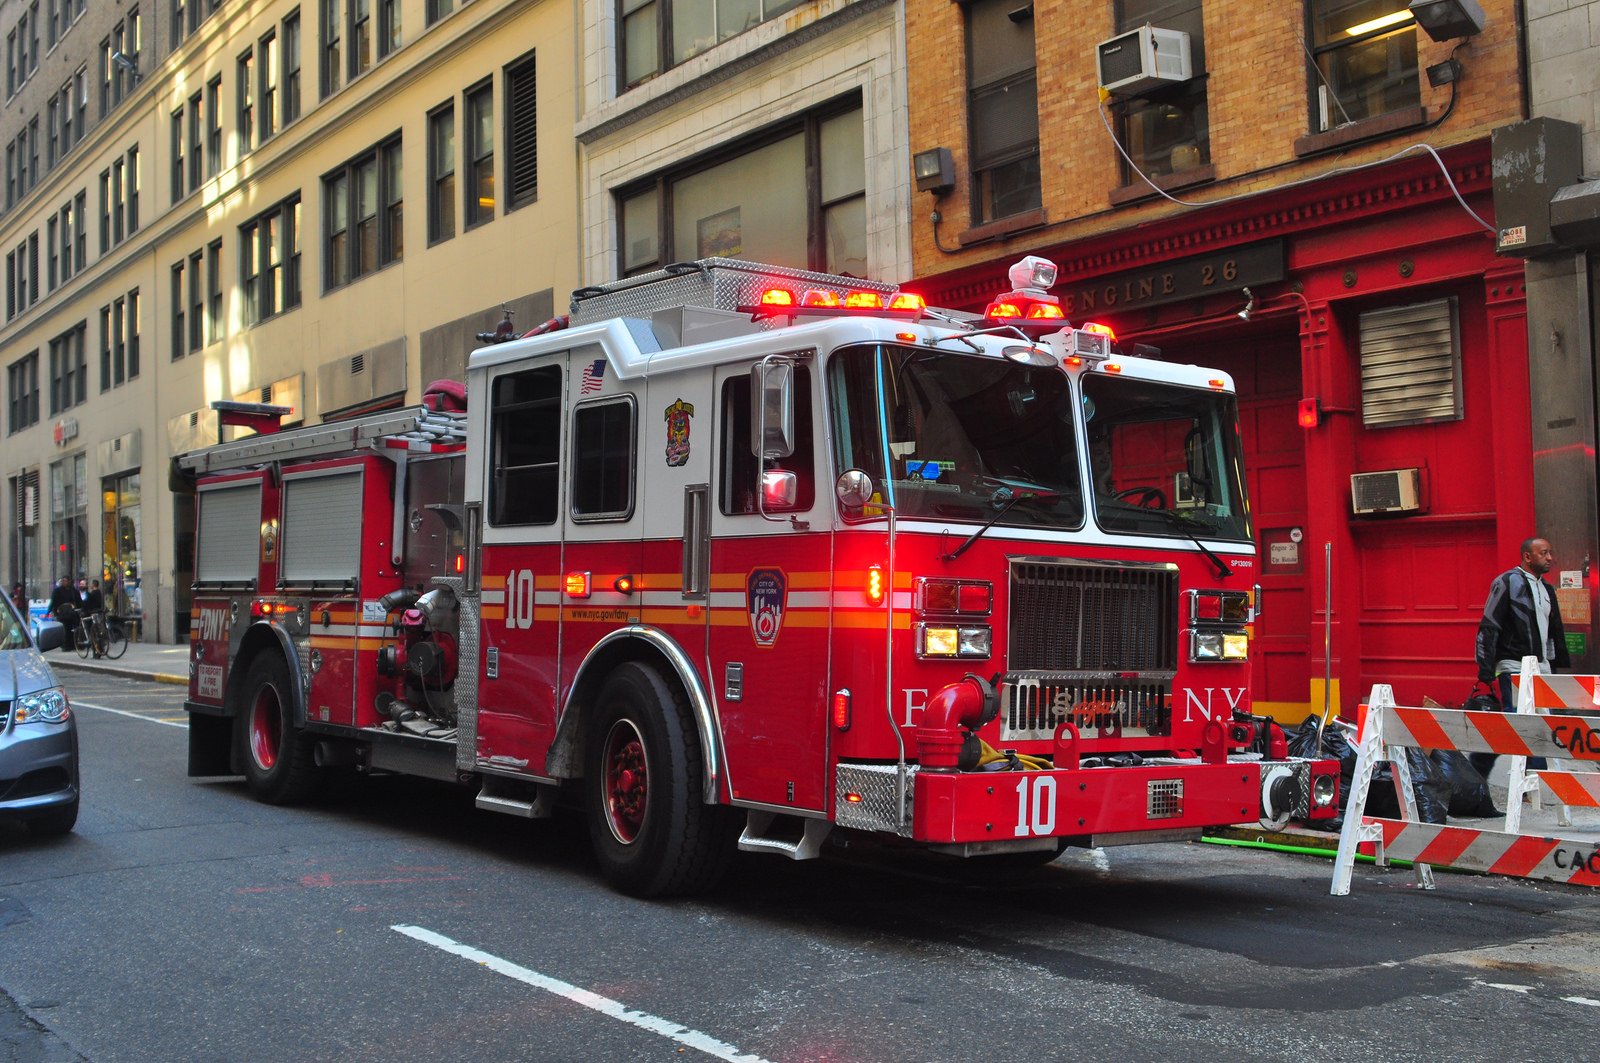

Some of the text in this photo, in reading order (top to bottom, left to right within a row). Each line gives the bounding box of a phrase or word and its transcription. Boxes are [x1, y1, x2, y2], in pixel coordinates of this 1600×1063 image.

[1065, 260, 1238, 314] ENGINE 26
[505, 569, 534, 629] 10
[571, 609, 629, 622] www.nyc.gov/fdny
[198, 608, 226, 641] FDNY
[900, 688, 929, 728] F
[1014, 775, 1057, 837] 10
